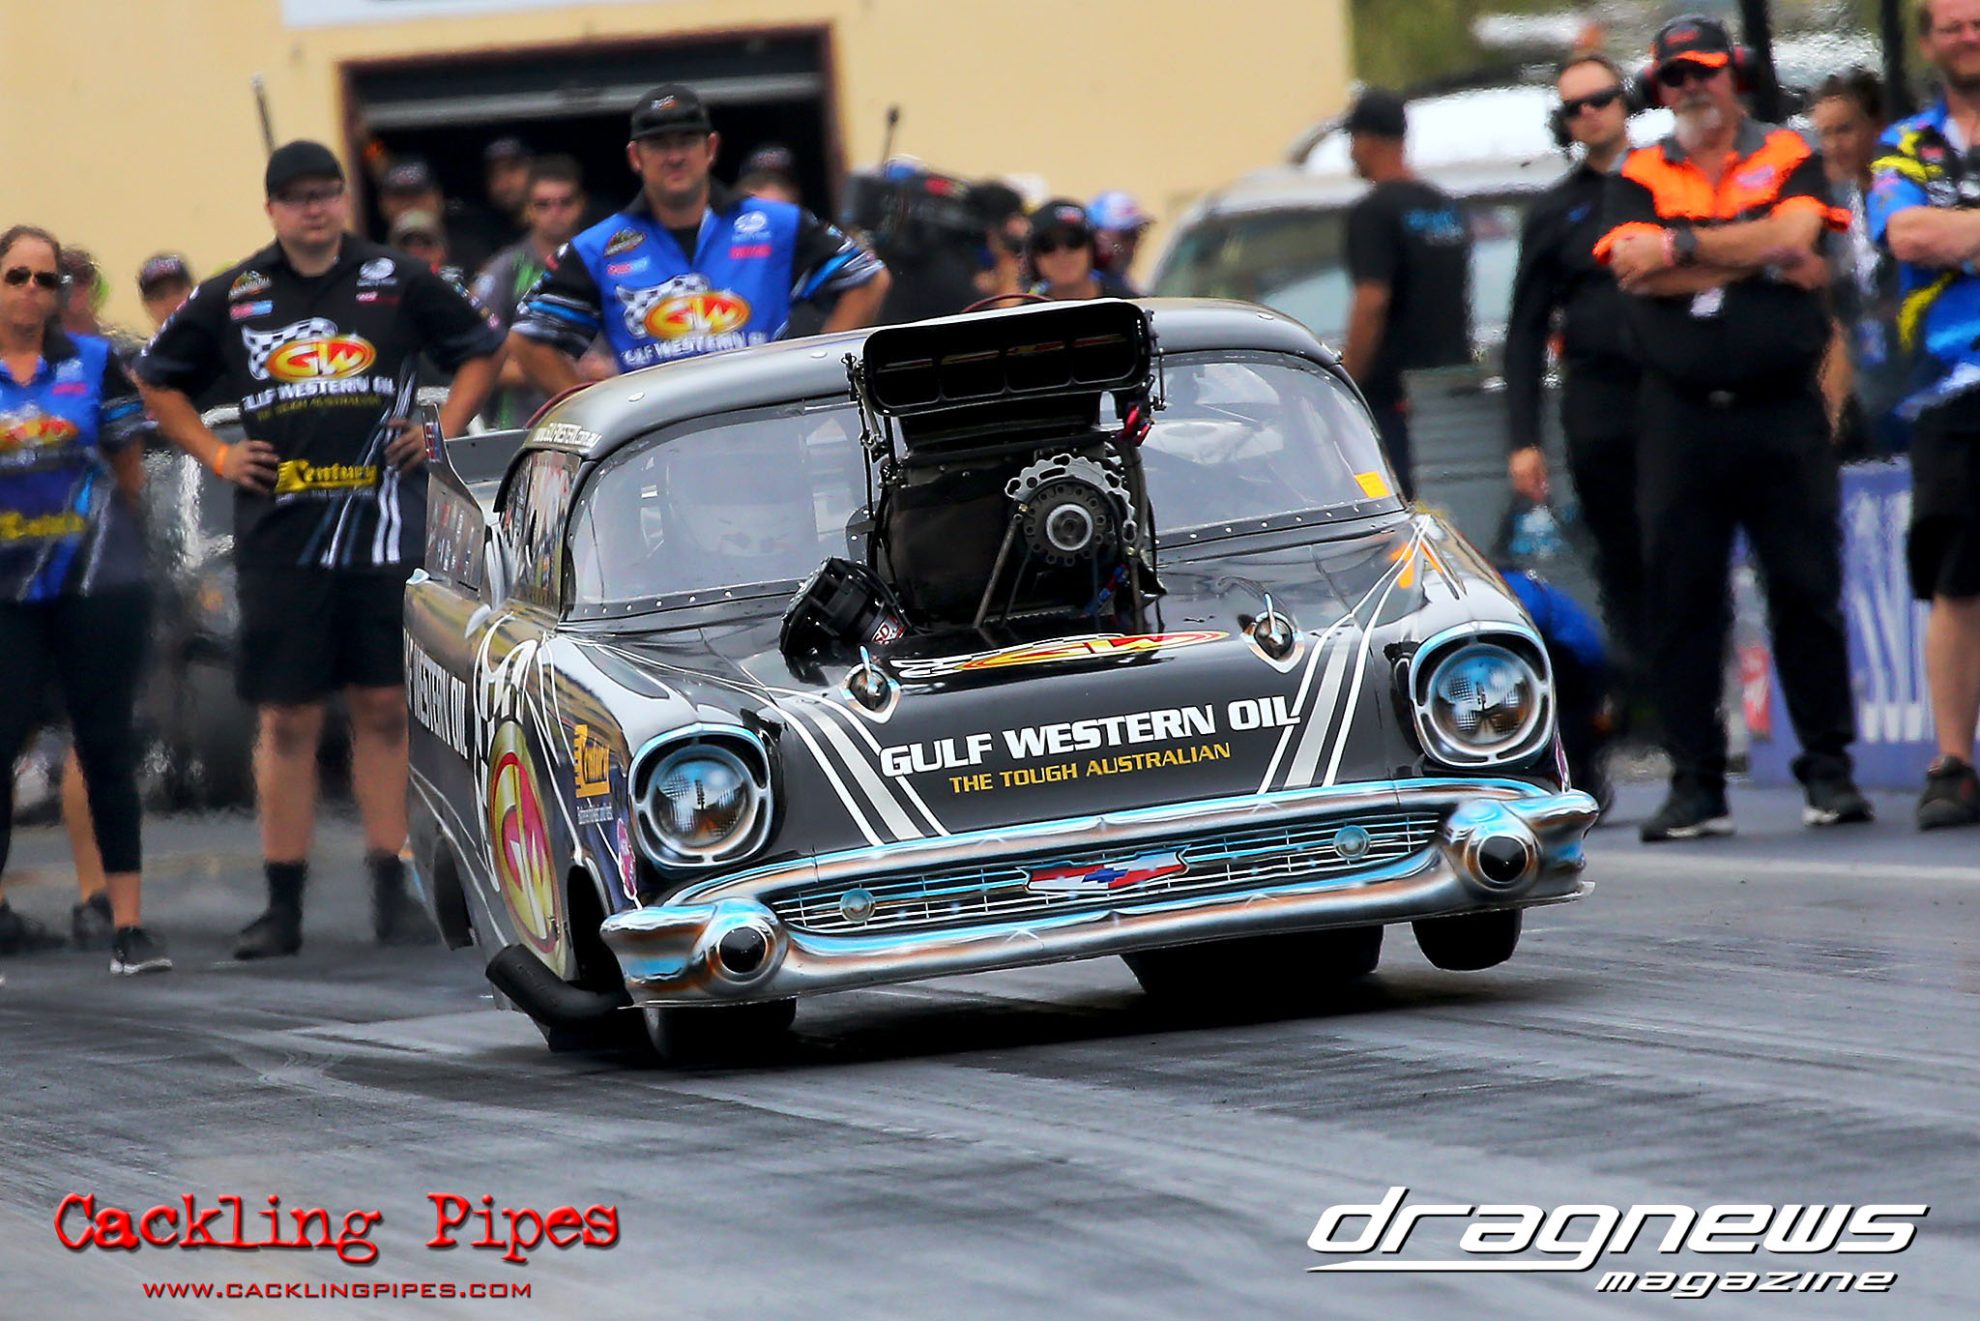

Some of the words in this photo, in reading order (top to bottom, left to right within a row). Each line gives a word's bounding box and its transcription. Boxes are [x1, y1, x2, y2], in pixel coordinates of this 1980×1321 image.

[880, 733, 993, 778] GULF
[1002, 704, 1215, 760] WESTERN
[1228, 695, 1301, 731] OIL
[949, 774, 994, 794] THE
[1000, 764, 1078, 788] TOUGH
[1086, 742, 1232, 777] AUSTRALIAN
